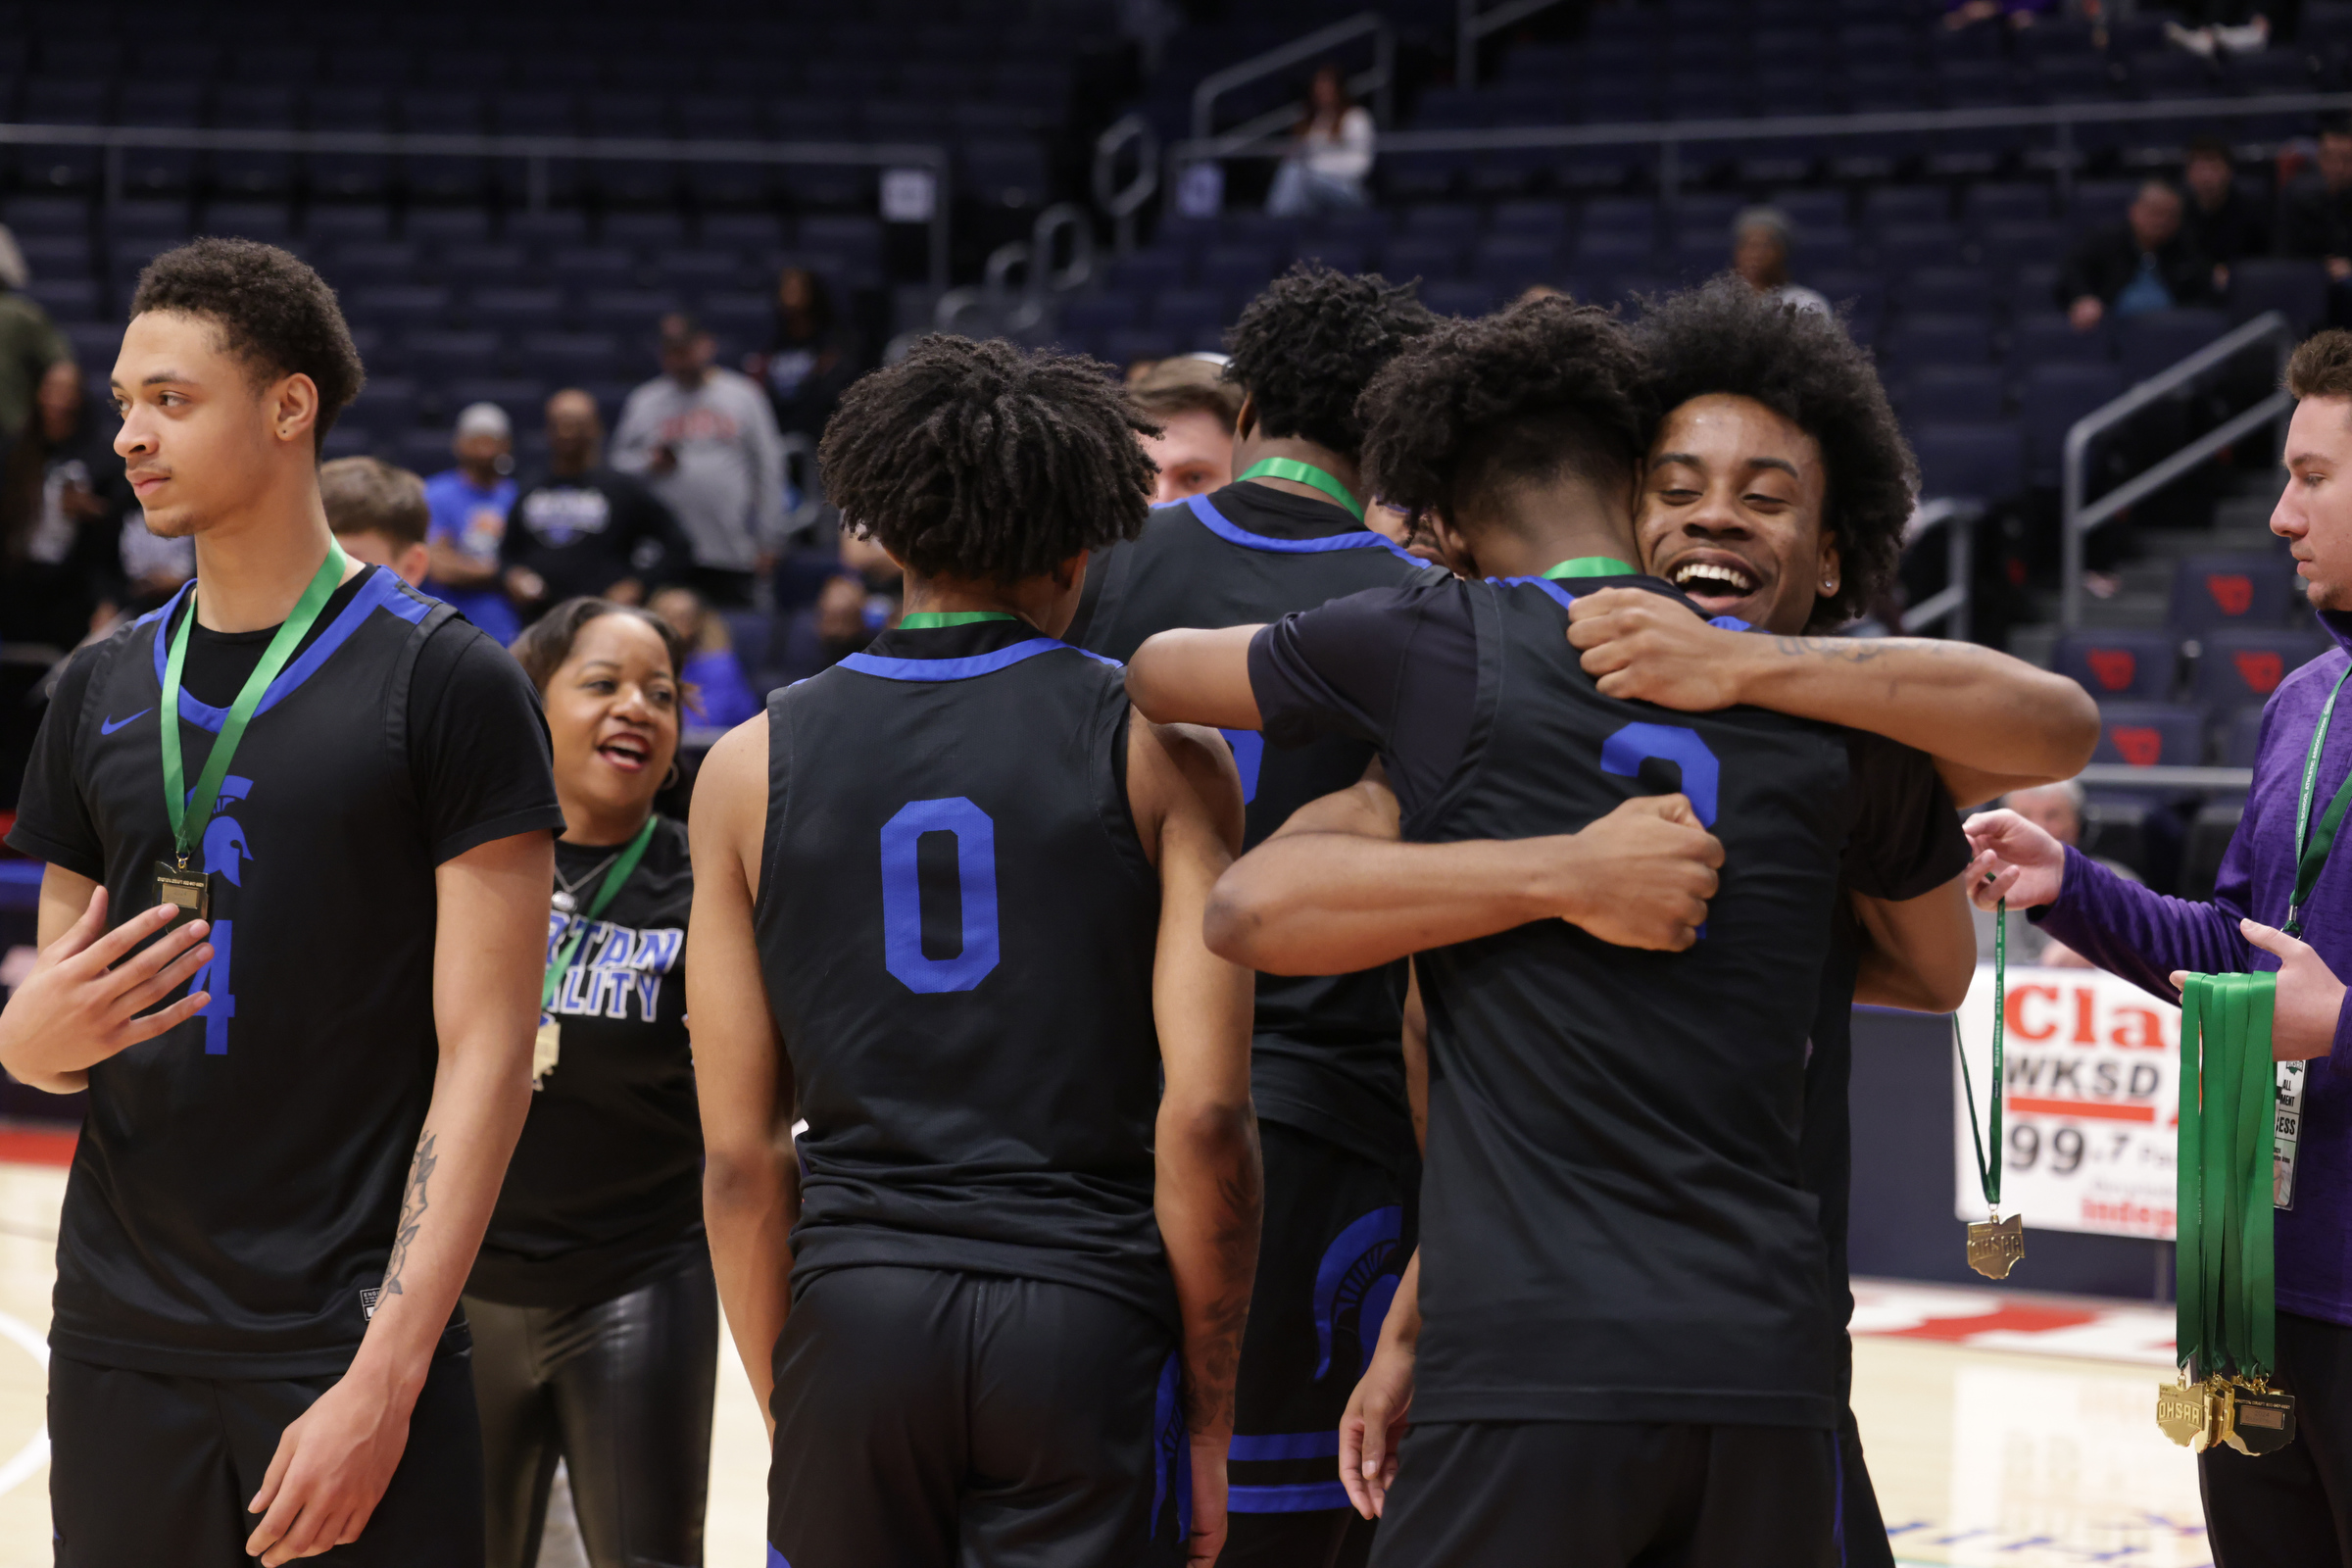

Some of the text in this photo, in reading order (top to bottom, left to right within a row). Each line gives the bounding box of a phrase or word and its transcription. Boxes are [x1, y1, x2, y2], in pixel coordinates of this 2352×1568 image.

[2305, 760, 2315, 790] ATHLETIC
[2312, 717, 2327, 759] ASSOCIATION
[880, 796, 1000, 995] 0
[187, 919, 235, 1055] 4
[2004, 983, 2182, 1052] Cla
[2006, 1055, 2161, 1099] WKSD
[2158, 1401, 2201, 1425] OHSAA
